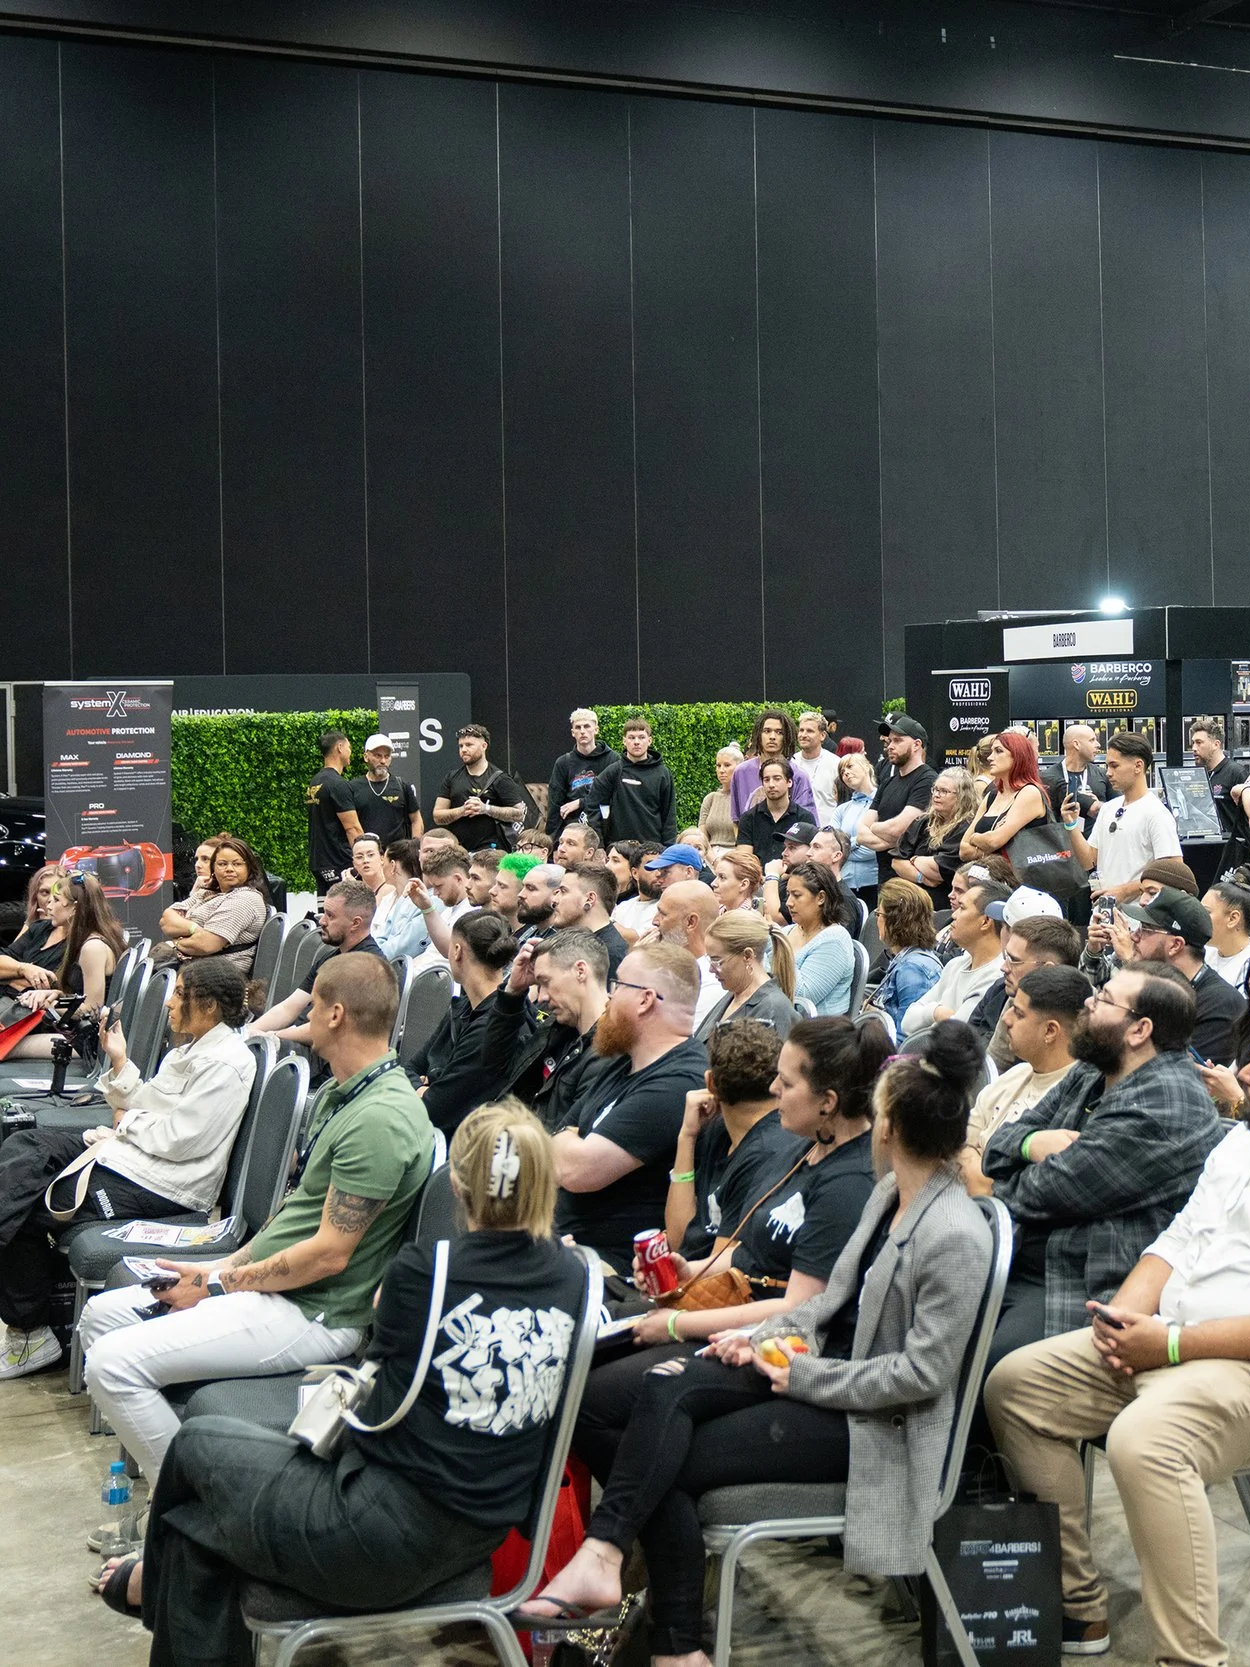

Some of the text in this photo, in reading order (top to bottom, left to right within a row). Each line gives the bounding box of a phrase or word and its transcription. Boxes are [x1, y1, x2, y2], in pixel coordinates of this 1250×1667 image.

[1053, 632, 1076, 648] BARBERCO
[1090, 663, 1152, 673] BARBERCO
[952, 682, 988, 697] WAHL
[1089, 692, 1134, 705] WAHL
[960, 717, 990, 725] BARBERCO
[111, 727, 155, 735] PROTECTION
[1010, 1629, 1037, 1643] JRL
